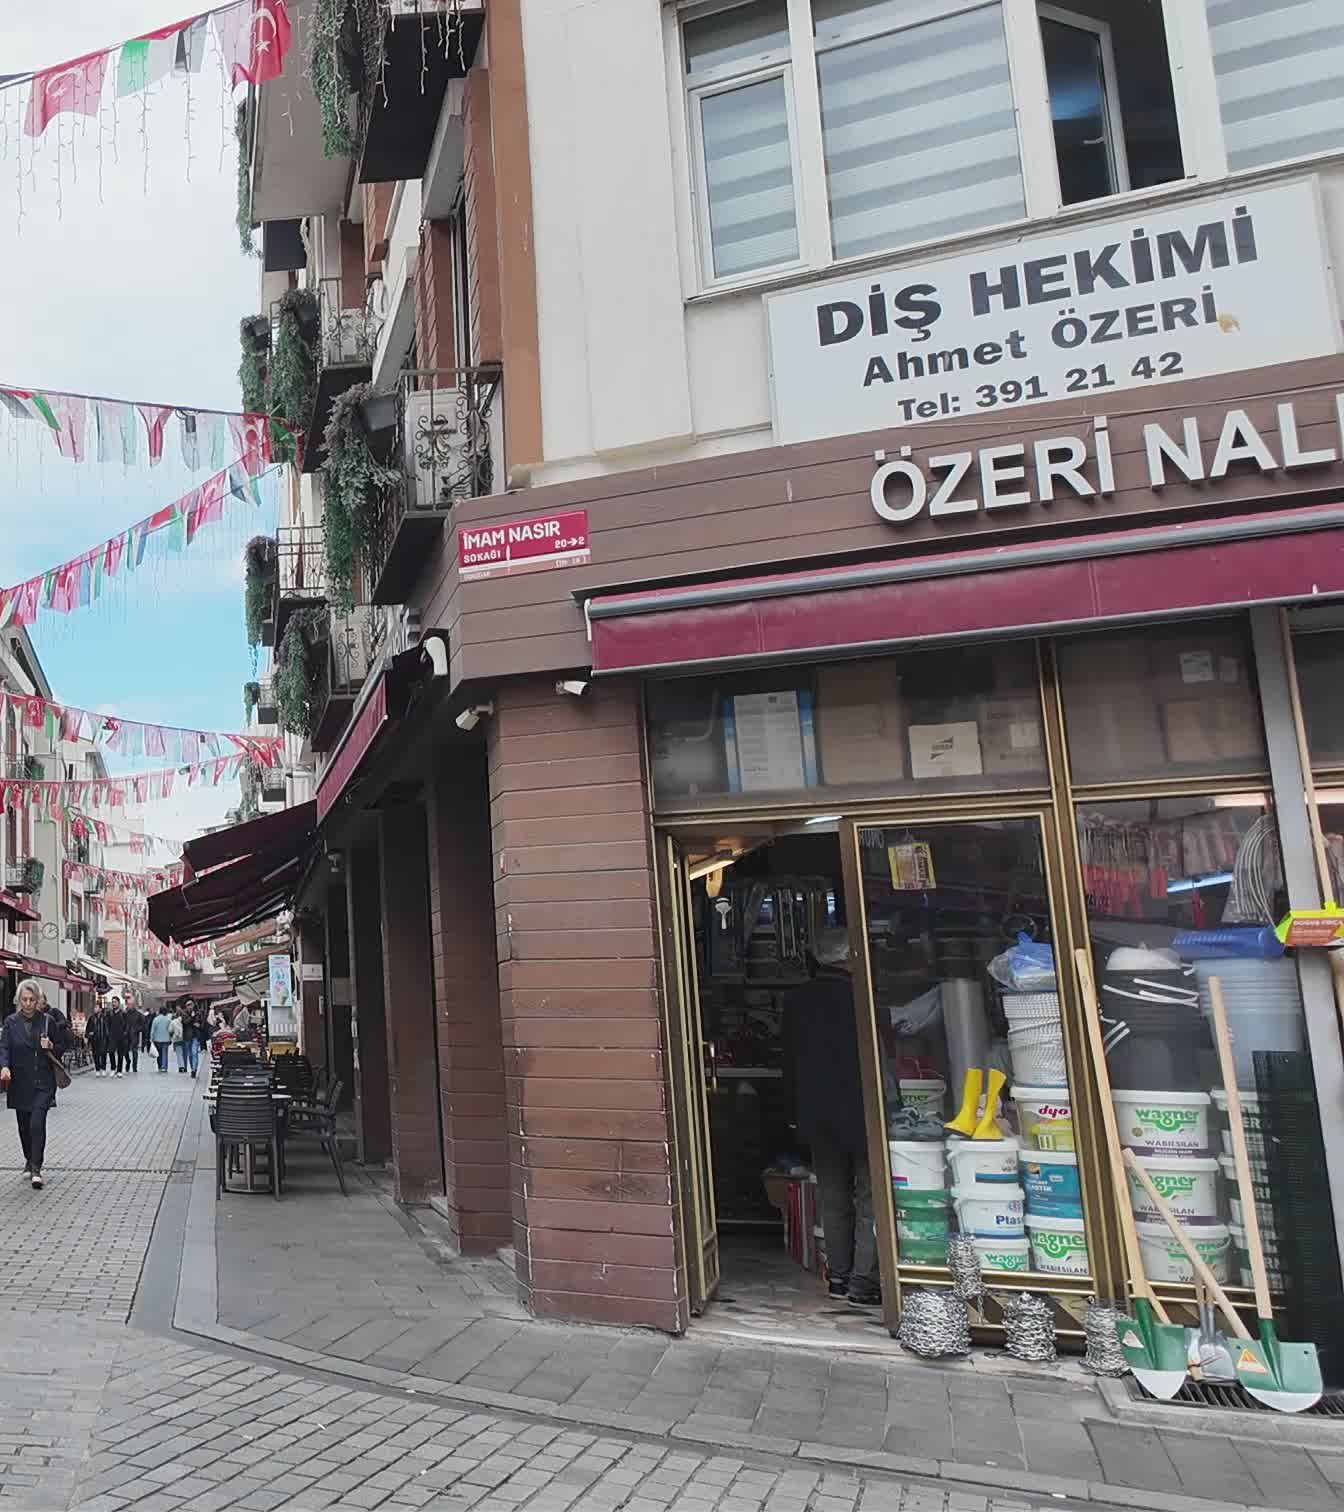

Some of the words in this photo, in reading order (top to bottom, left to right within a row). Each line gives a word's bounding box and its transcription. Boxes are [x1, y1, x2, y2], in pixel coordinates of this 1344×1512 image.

[817, 283, 943, 345] DİŞ
[969, 205, 1258, 316] HEKİMİ
[863, 329, 1028, 388] Ahmet
[1050, 284, 1218, 349] ÖZERİ
[897, 393, 961, 421] Tel:
[975, 375, 1048, 408] 391
[1065, 363, 1115, 393] 21
[1131, 351, 1185, 380] 42
[869, 416, 1115, 523] ÖZERİ
[1142, 393, 1344, 487] NAL
[462, 529, 505, 550] İMAM
[508, 520, 561, 543] NASIR
[463, 549, 501, 563] SOKAĞI
[1038, 1104, 1069, 1119] dyo
[1136, 1108, 1200, 1127] wagner
